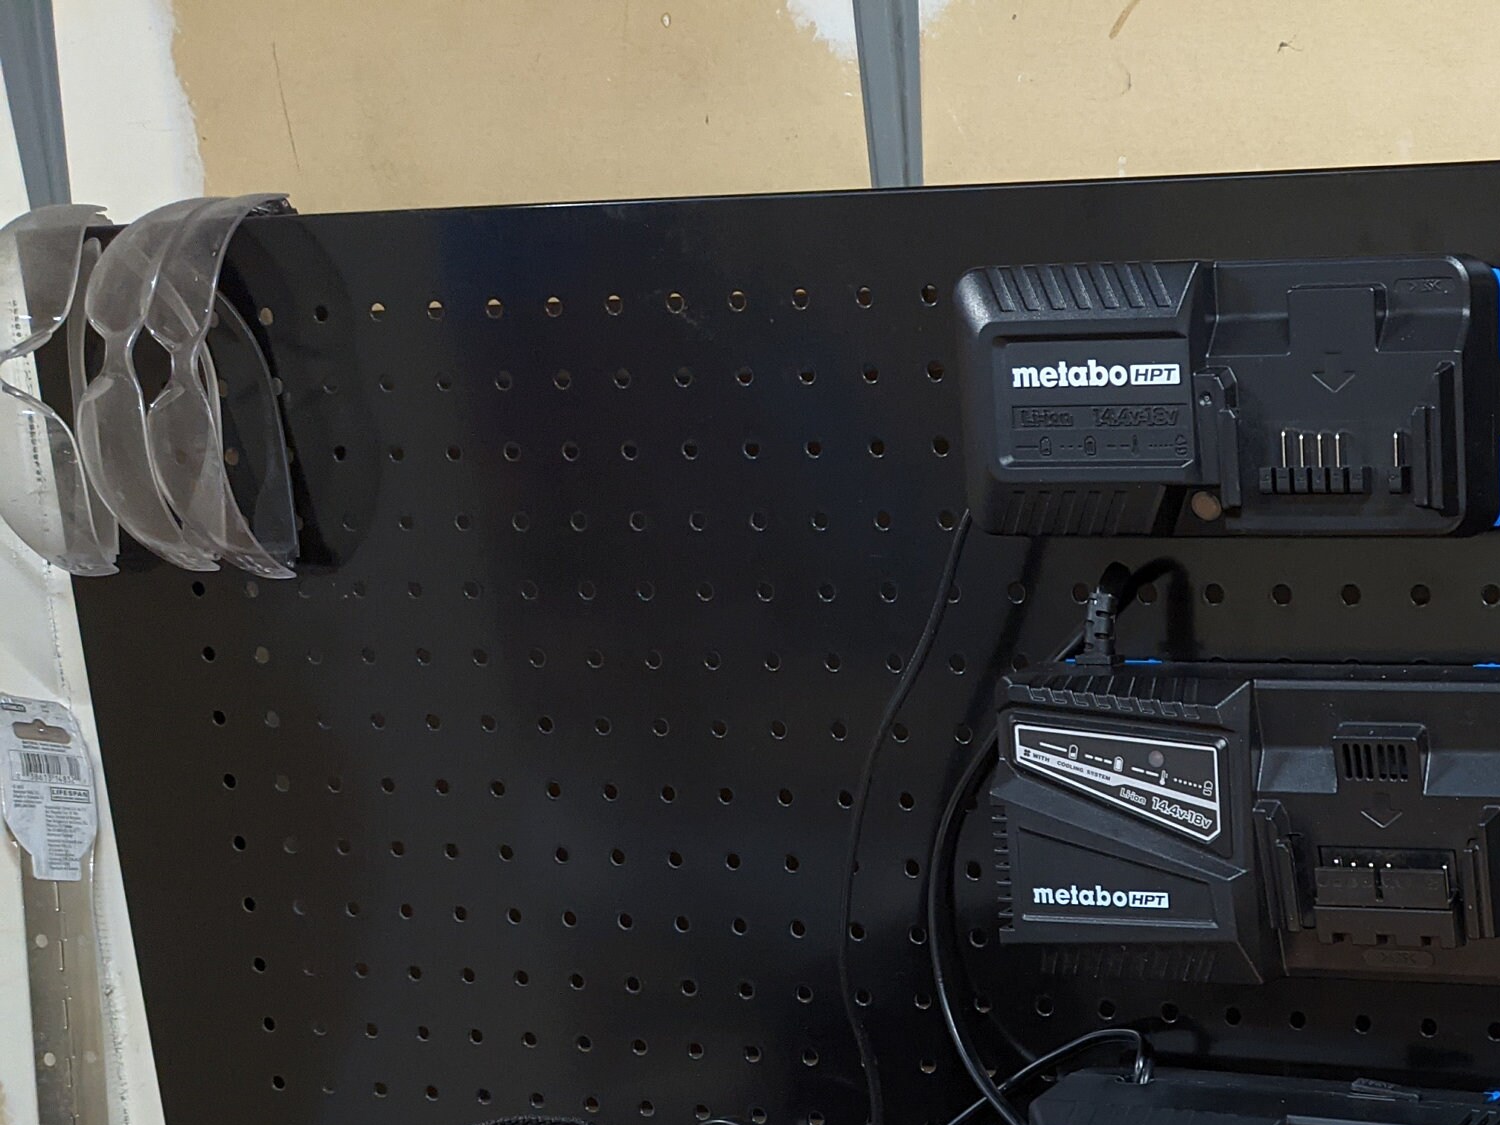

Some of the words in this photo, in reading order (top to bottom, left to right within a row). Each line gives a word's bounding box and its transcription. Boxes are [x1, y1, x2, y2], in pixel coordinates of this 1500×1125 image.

[1012, 359, 1127, 388] metabo
[1133, 366, 1178, 383] HPT
[1032, 752, 1050, 763] WITH
[1057, 760, 1084, 773] COOLING
[52, 788, 88, 797] LIFESPAN
[1033, 885, 1127, 907] metabo
[1130, 893, 1168, 907] HPT
